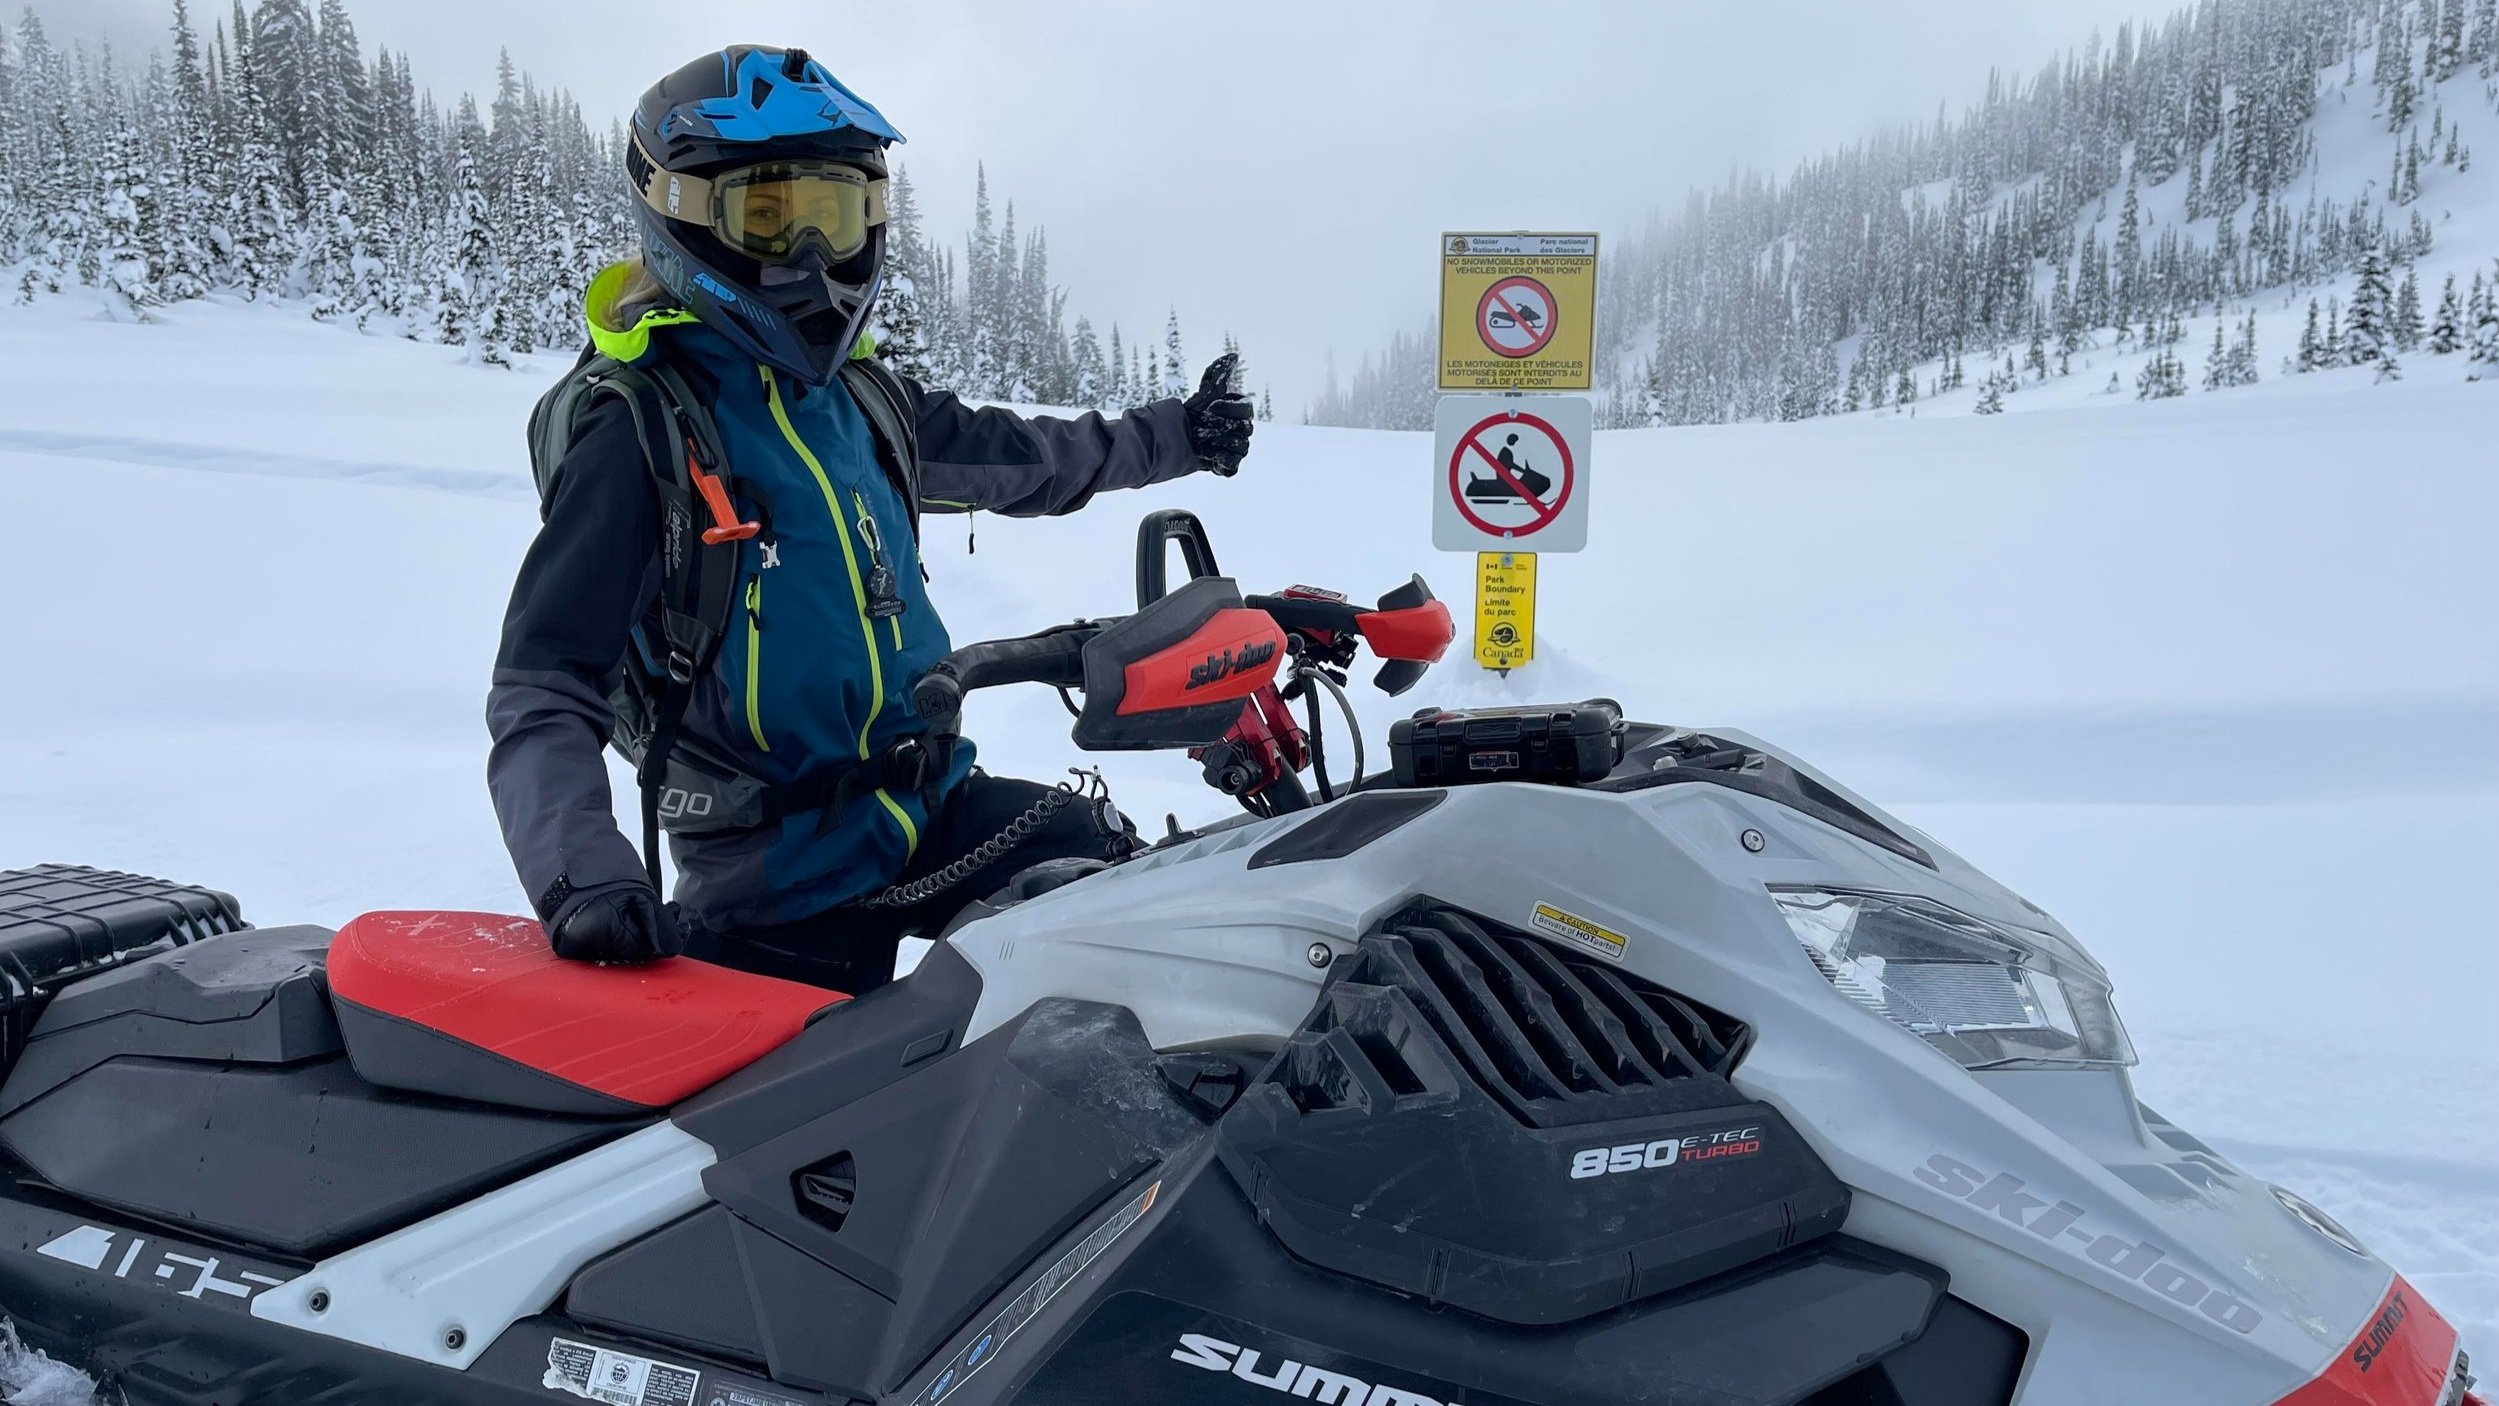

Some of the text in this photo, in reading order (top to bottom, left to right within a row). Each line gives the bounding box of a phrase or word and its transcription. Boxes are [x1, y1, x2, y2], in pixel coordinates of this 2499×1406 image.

[1447, 258, 1592, 266] NO SNOWMOBILES OR MOTORIZED
[1455, 267, 1582, 275] VEHICLES BEYOND THIS POINT
[1498, 369, 1521, 377] SONT
[1523, 369, 1568, 377] INTERDITS
[1569, 369, 1582, 377] AU
[1512, 378, 1525, 386] CE
[1485, 575, 1505, 584] Park
[1485, 585, 1526, 595] Boundary
[1484, 599, 1511, 607] Limite
[1484, 608, 1517, 617] du parc
[1482, 647, 1524, 658] Canada
[1185, 640, 1276, 690] ski-doo
[657, 784, 713, 818] go
[1538, 914, 1567, 932] Beware
[1566, 917, 1600, 935] CAUTION
[1570, 1127, 1759, 1179] 850 E-TEC
[1681, 1140, 1760, 1161] TURBO
[1912, 1153, 2263, 1334] ski-doo
[2353, 1290, 2408, 1373] SUMMIT
